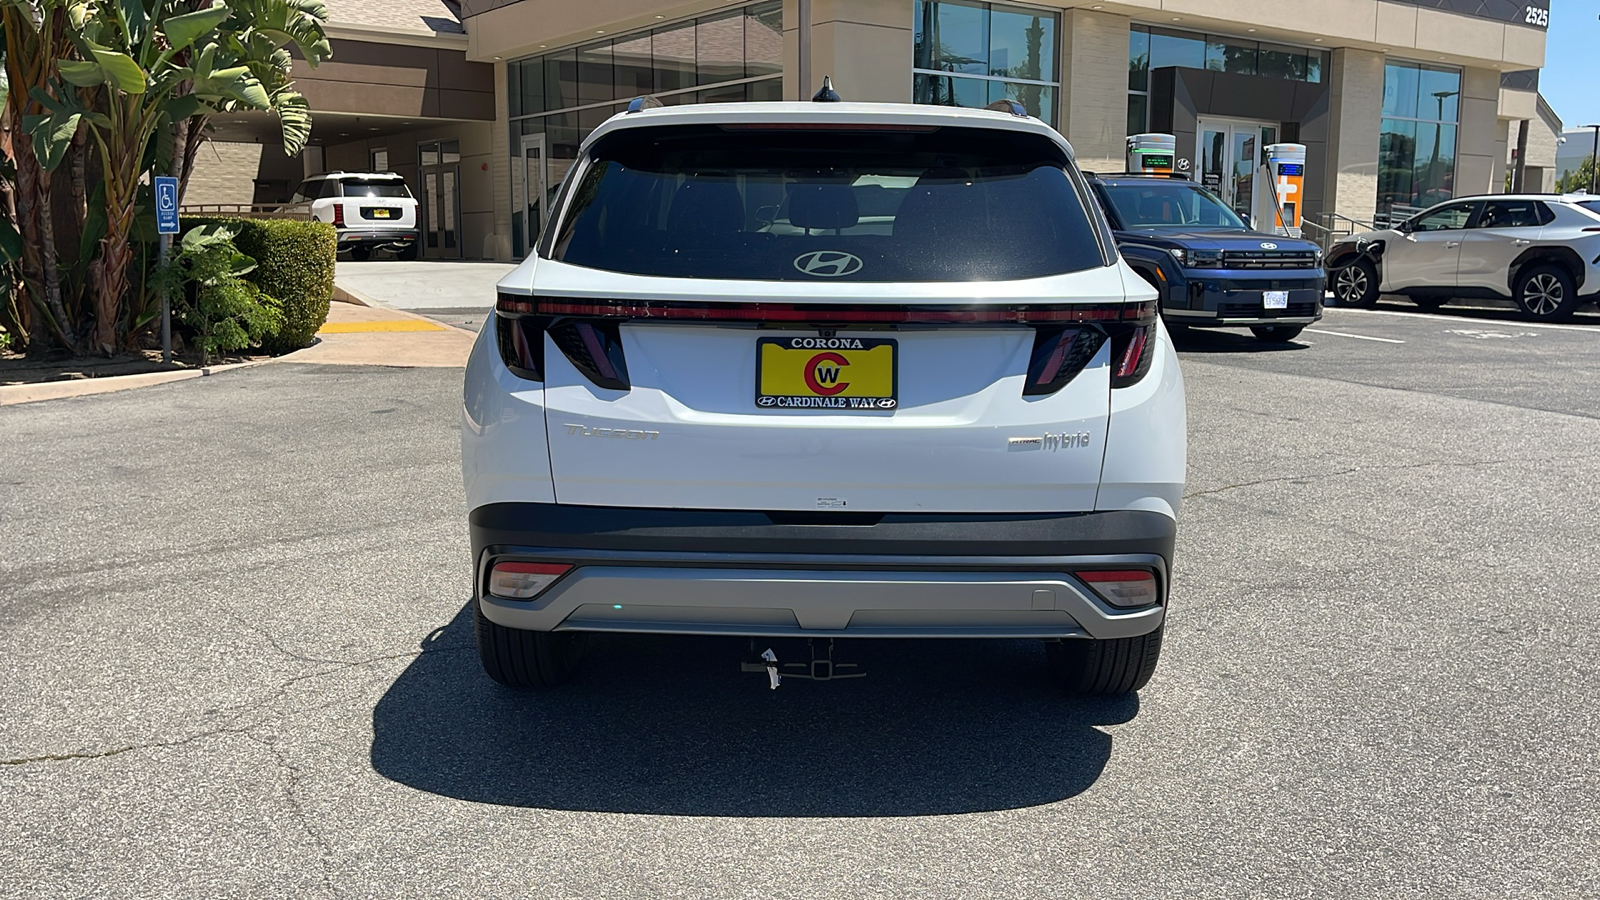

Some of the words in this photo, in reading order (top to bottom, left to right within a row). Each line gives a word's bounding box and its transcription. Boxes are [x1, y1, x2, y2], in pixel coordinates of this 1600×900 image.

[1525, 6, 1548, 27] 2525
[791, 338, 864, 349] CORONA
[804, 352, 850, 396] C
[817, 366, 840, 383] W
[777, 397, 846, 408] CARDINALE
[849, 397, 877, 408] WAY
[1043, 431, 1090, 453] hybrid
